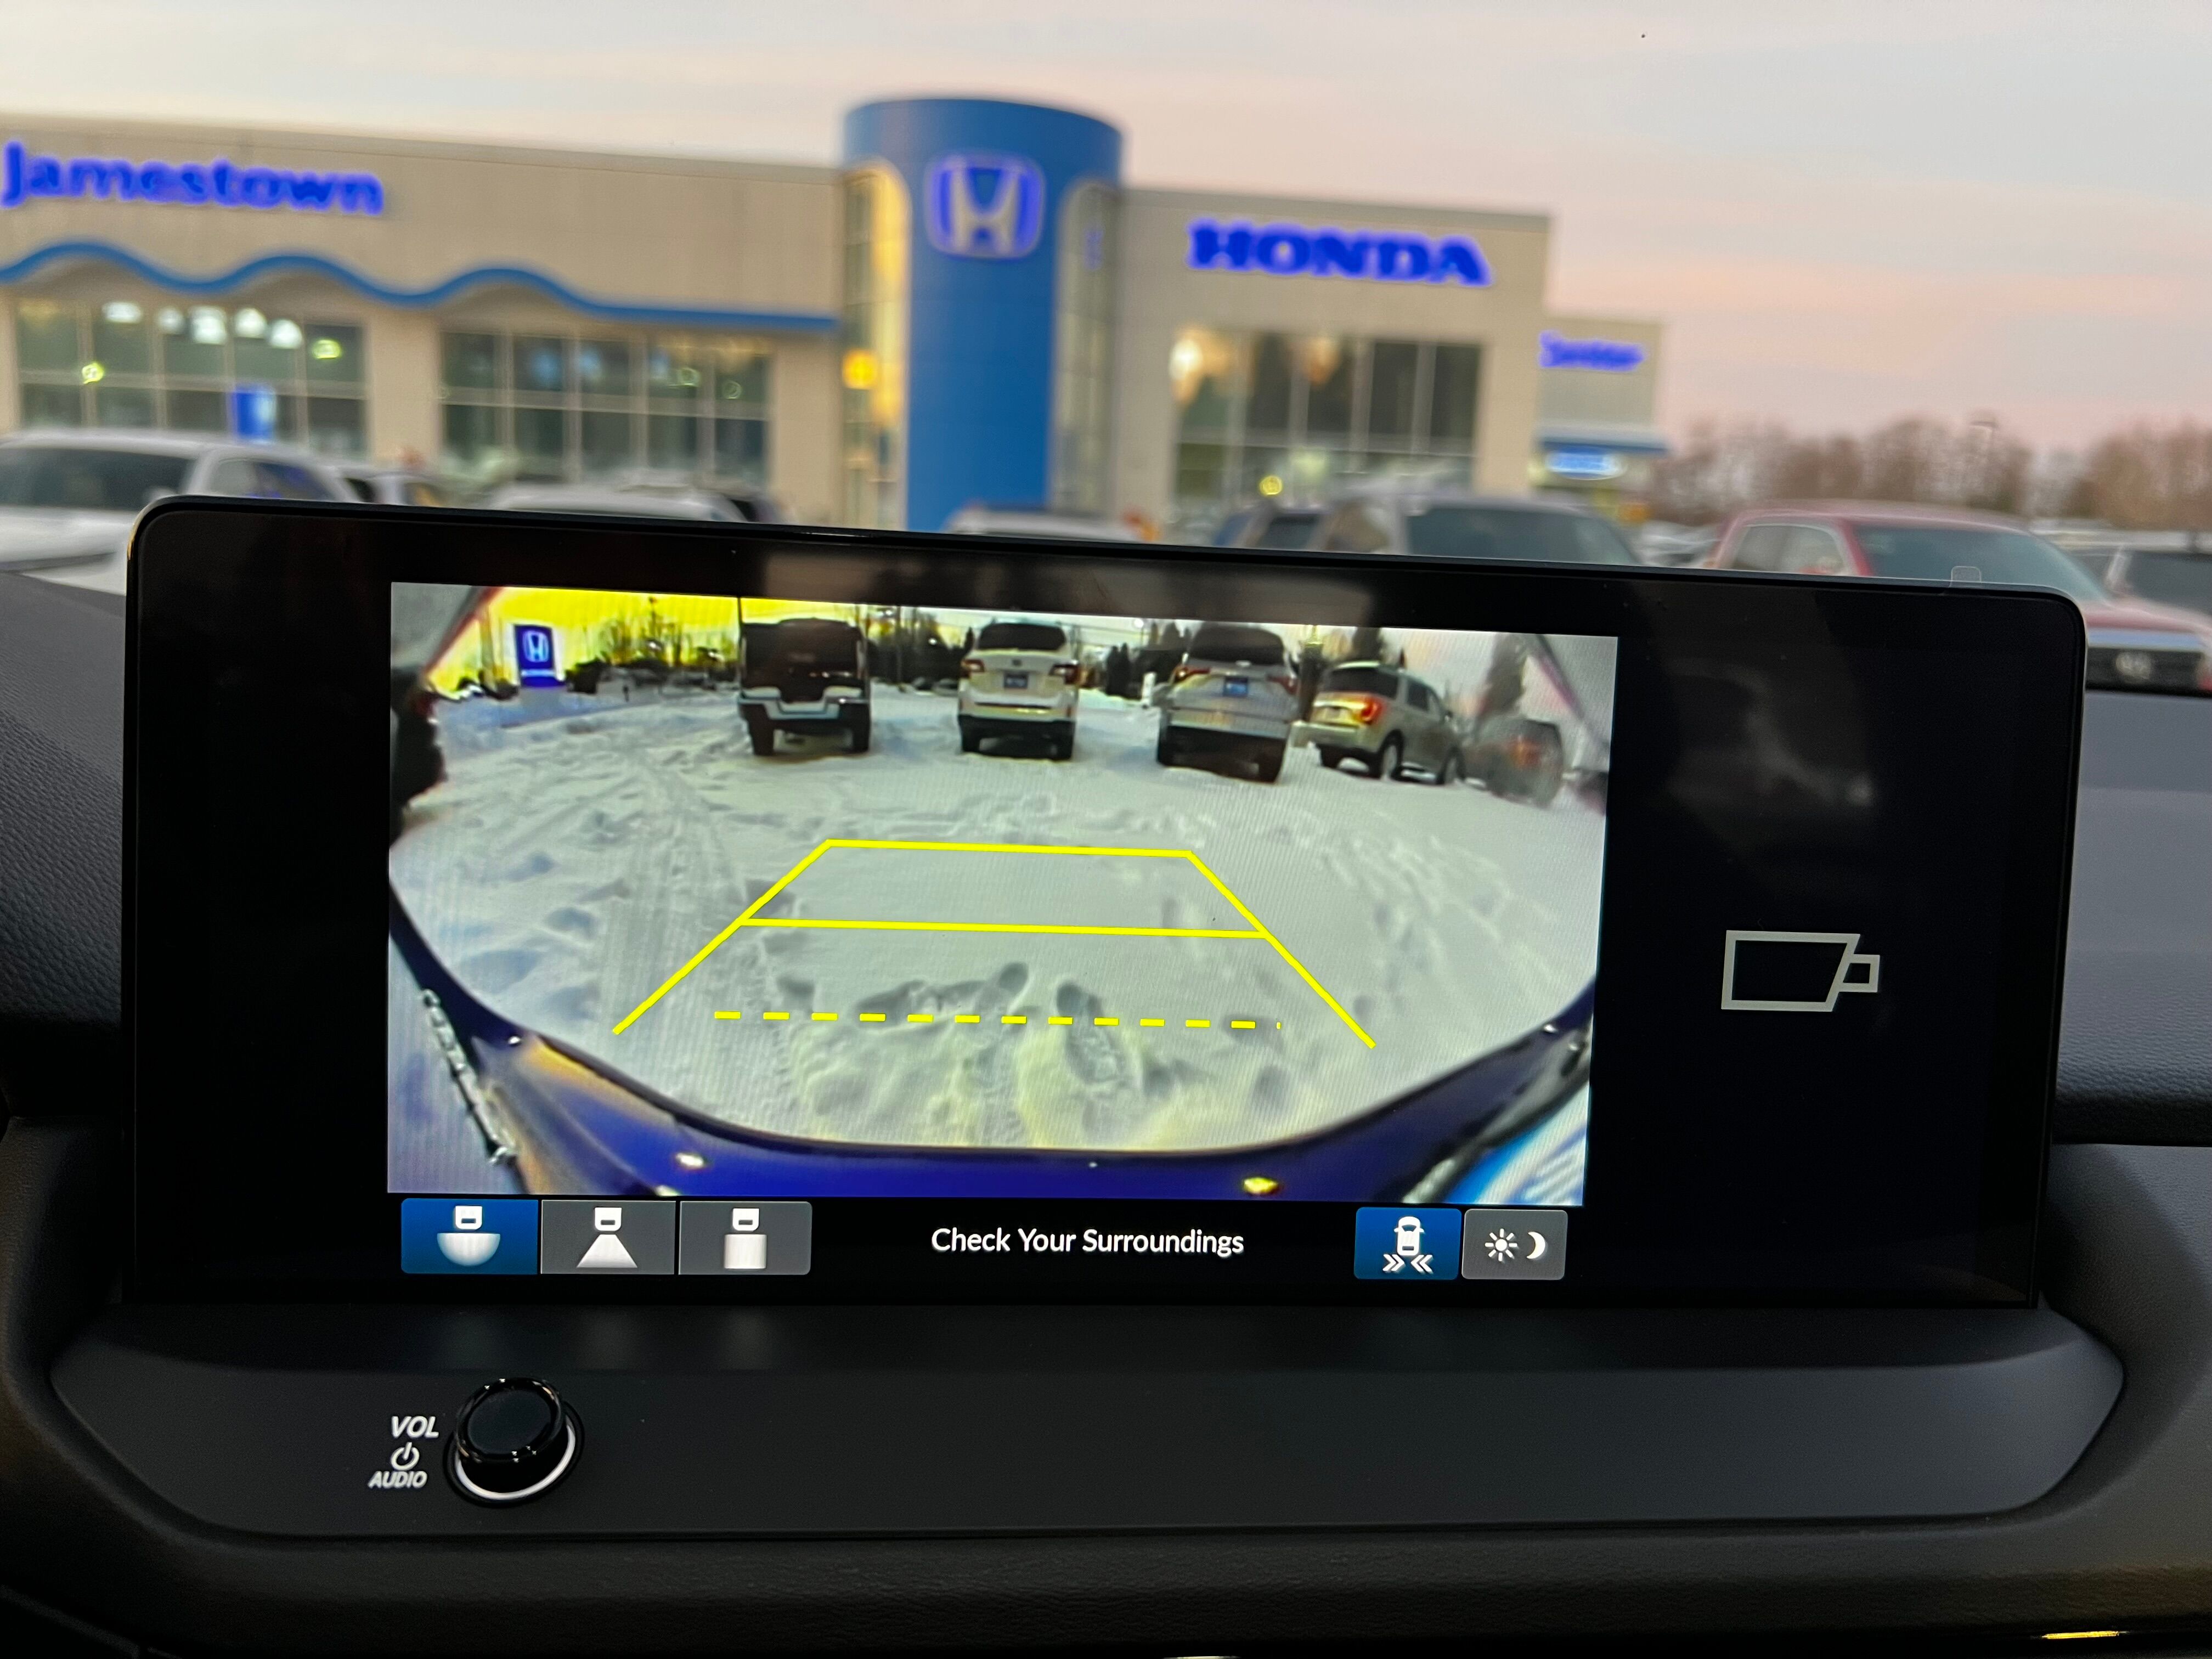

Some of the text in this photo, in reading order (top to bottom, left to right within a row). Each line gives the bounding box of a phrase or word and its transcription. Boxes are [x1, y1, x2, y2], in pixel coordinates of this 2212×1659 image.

[0, 141, 383, 215] Jamestown
[1187, 218, 1491, 286] HONDA
[931, 1227, 1244, 1258] Check Your Surroundings
[391, 1415, 439, 1438] VOL
[368, 1470, 428, 1489] AUDIO
